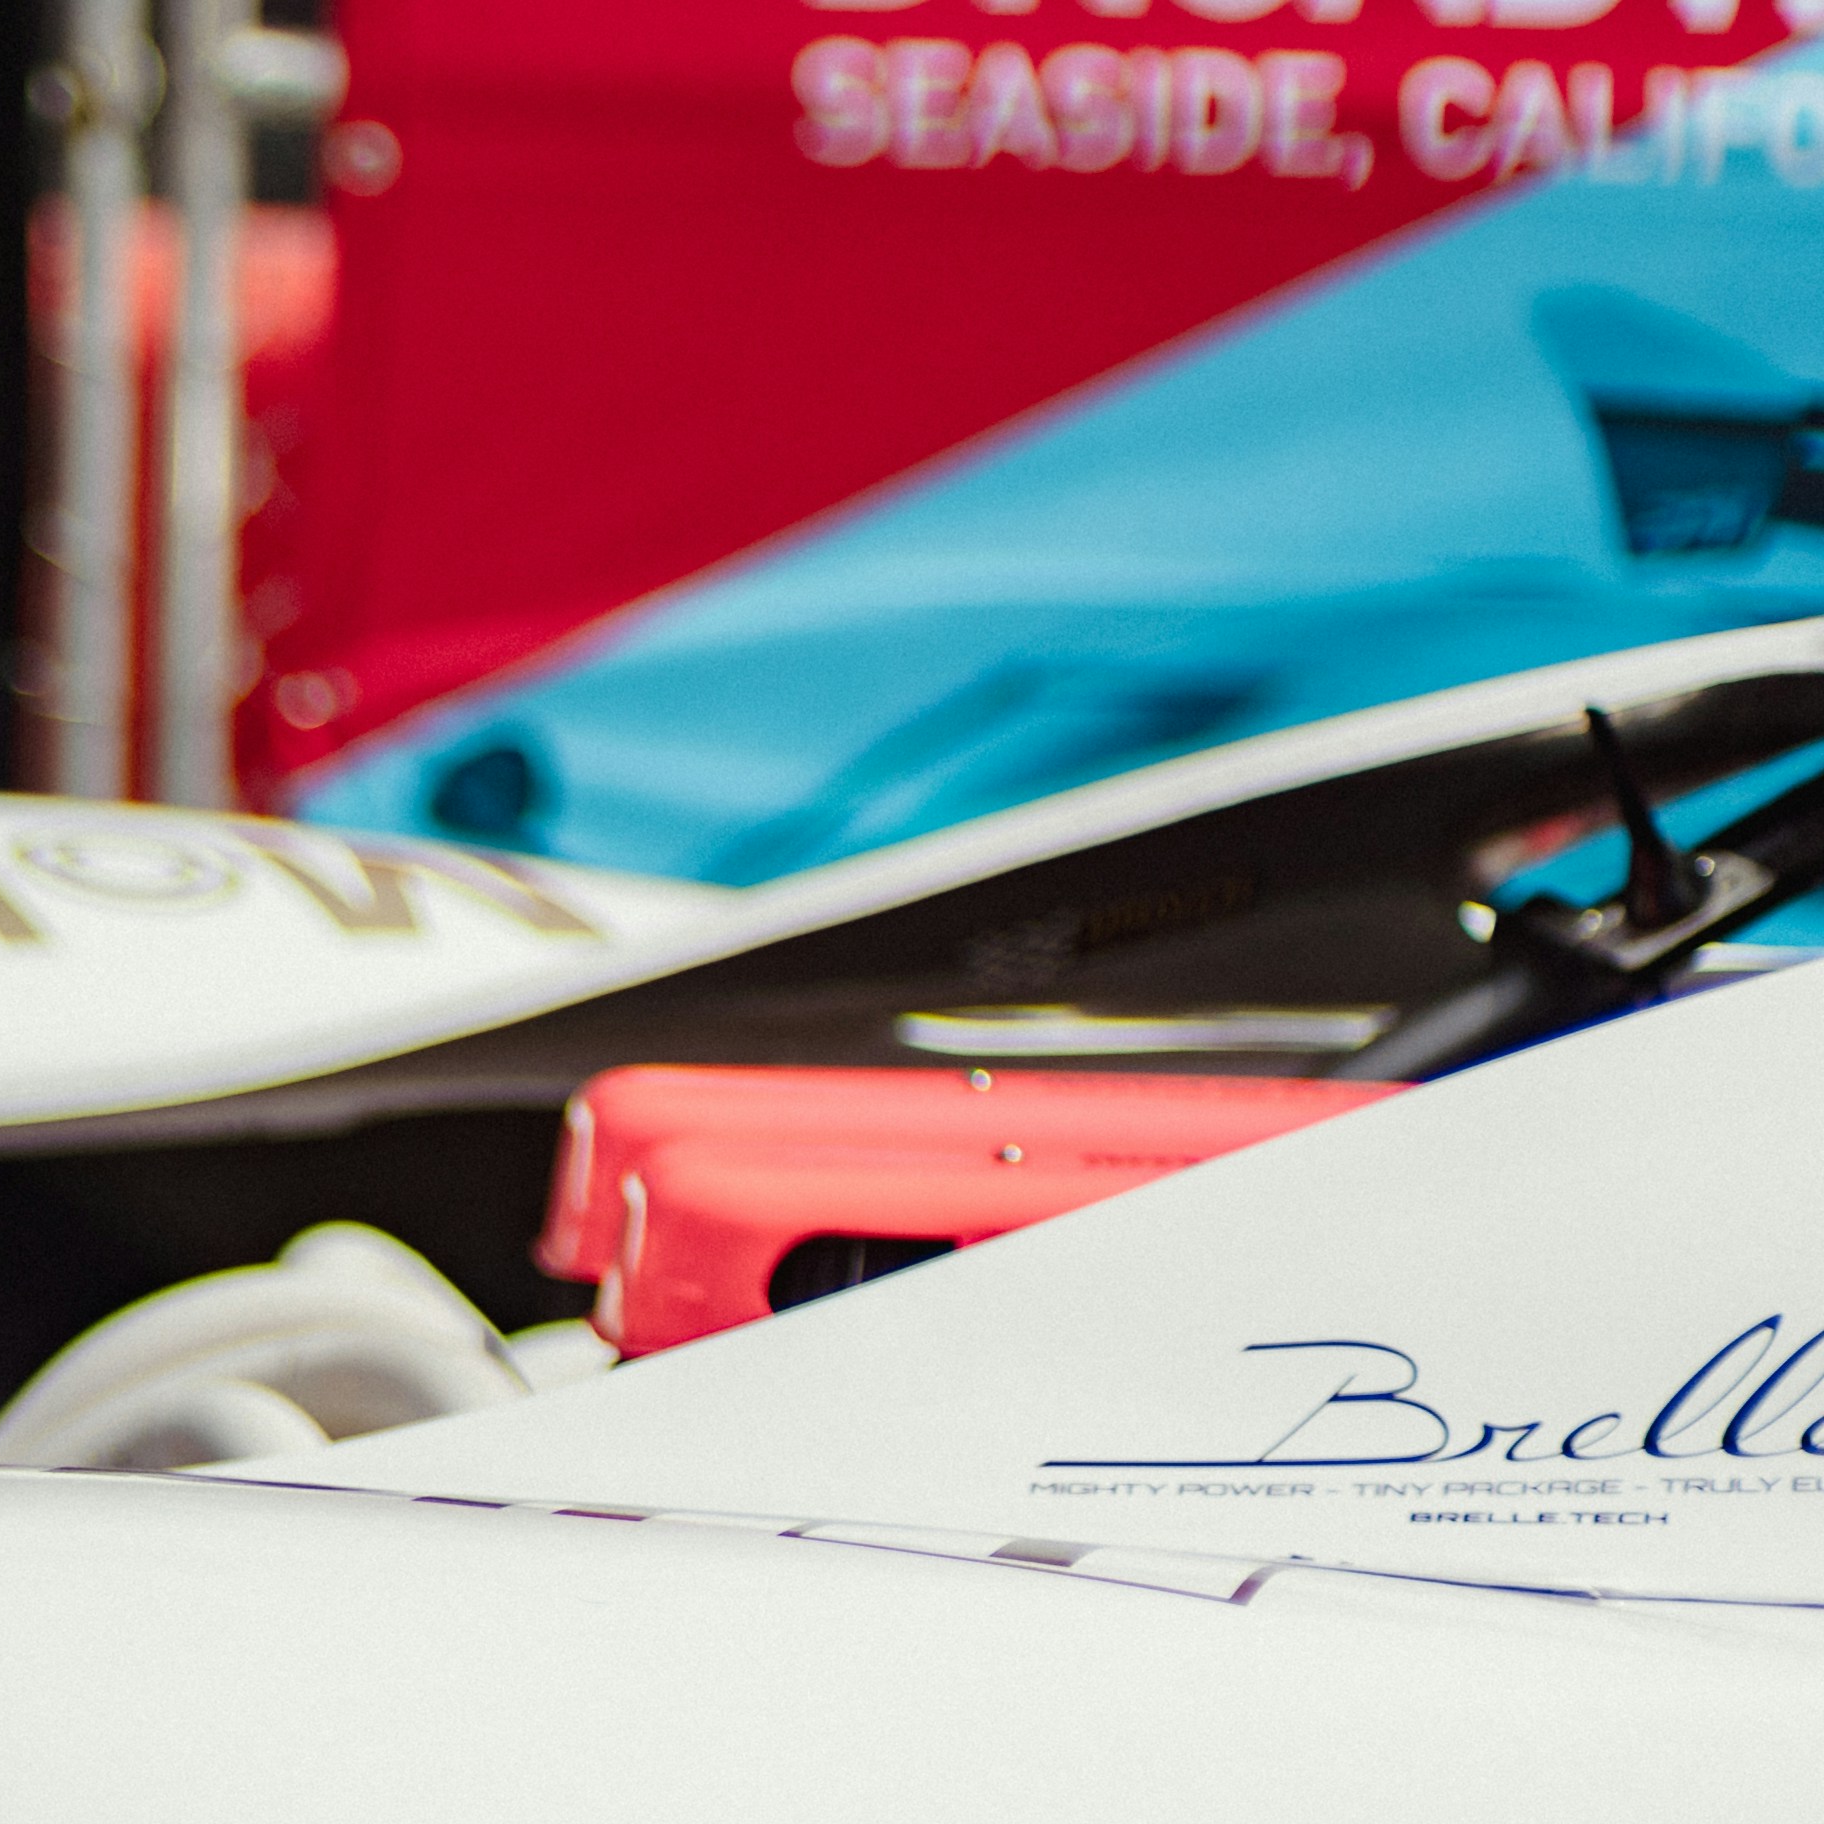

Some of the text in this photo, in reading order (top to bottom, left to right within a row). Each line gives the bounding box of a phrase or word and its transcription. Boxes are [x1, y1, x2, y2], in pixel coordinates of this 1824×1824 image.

[790, 34, 1376, 190] SEASIDE,
[1029, 1480, 1167, 1497] MIGHTY
[1176, 1481, 1315, 1497] POWER
[1352, 1480, 1435, 1498] TINY
[1442, 1478, 1624, 1497] PACKAGE
[1660, 1476, 1782, 1494] TRULY
[1408, 1510, 1670, 1526] BRELLE.TECH
